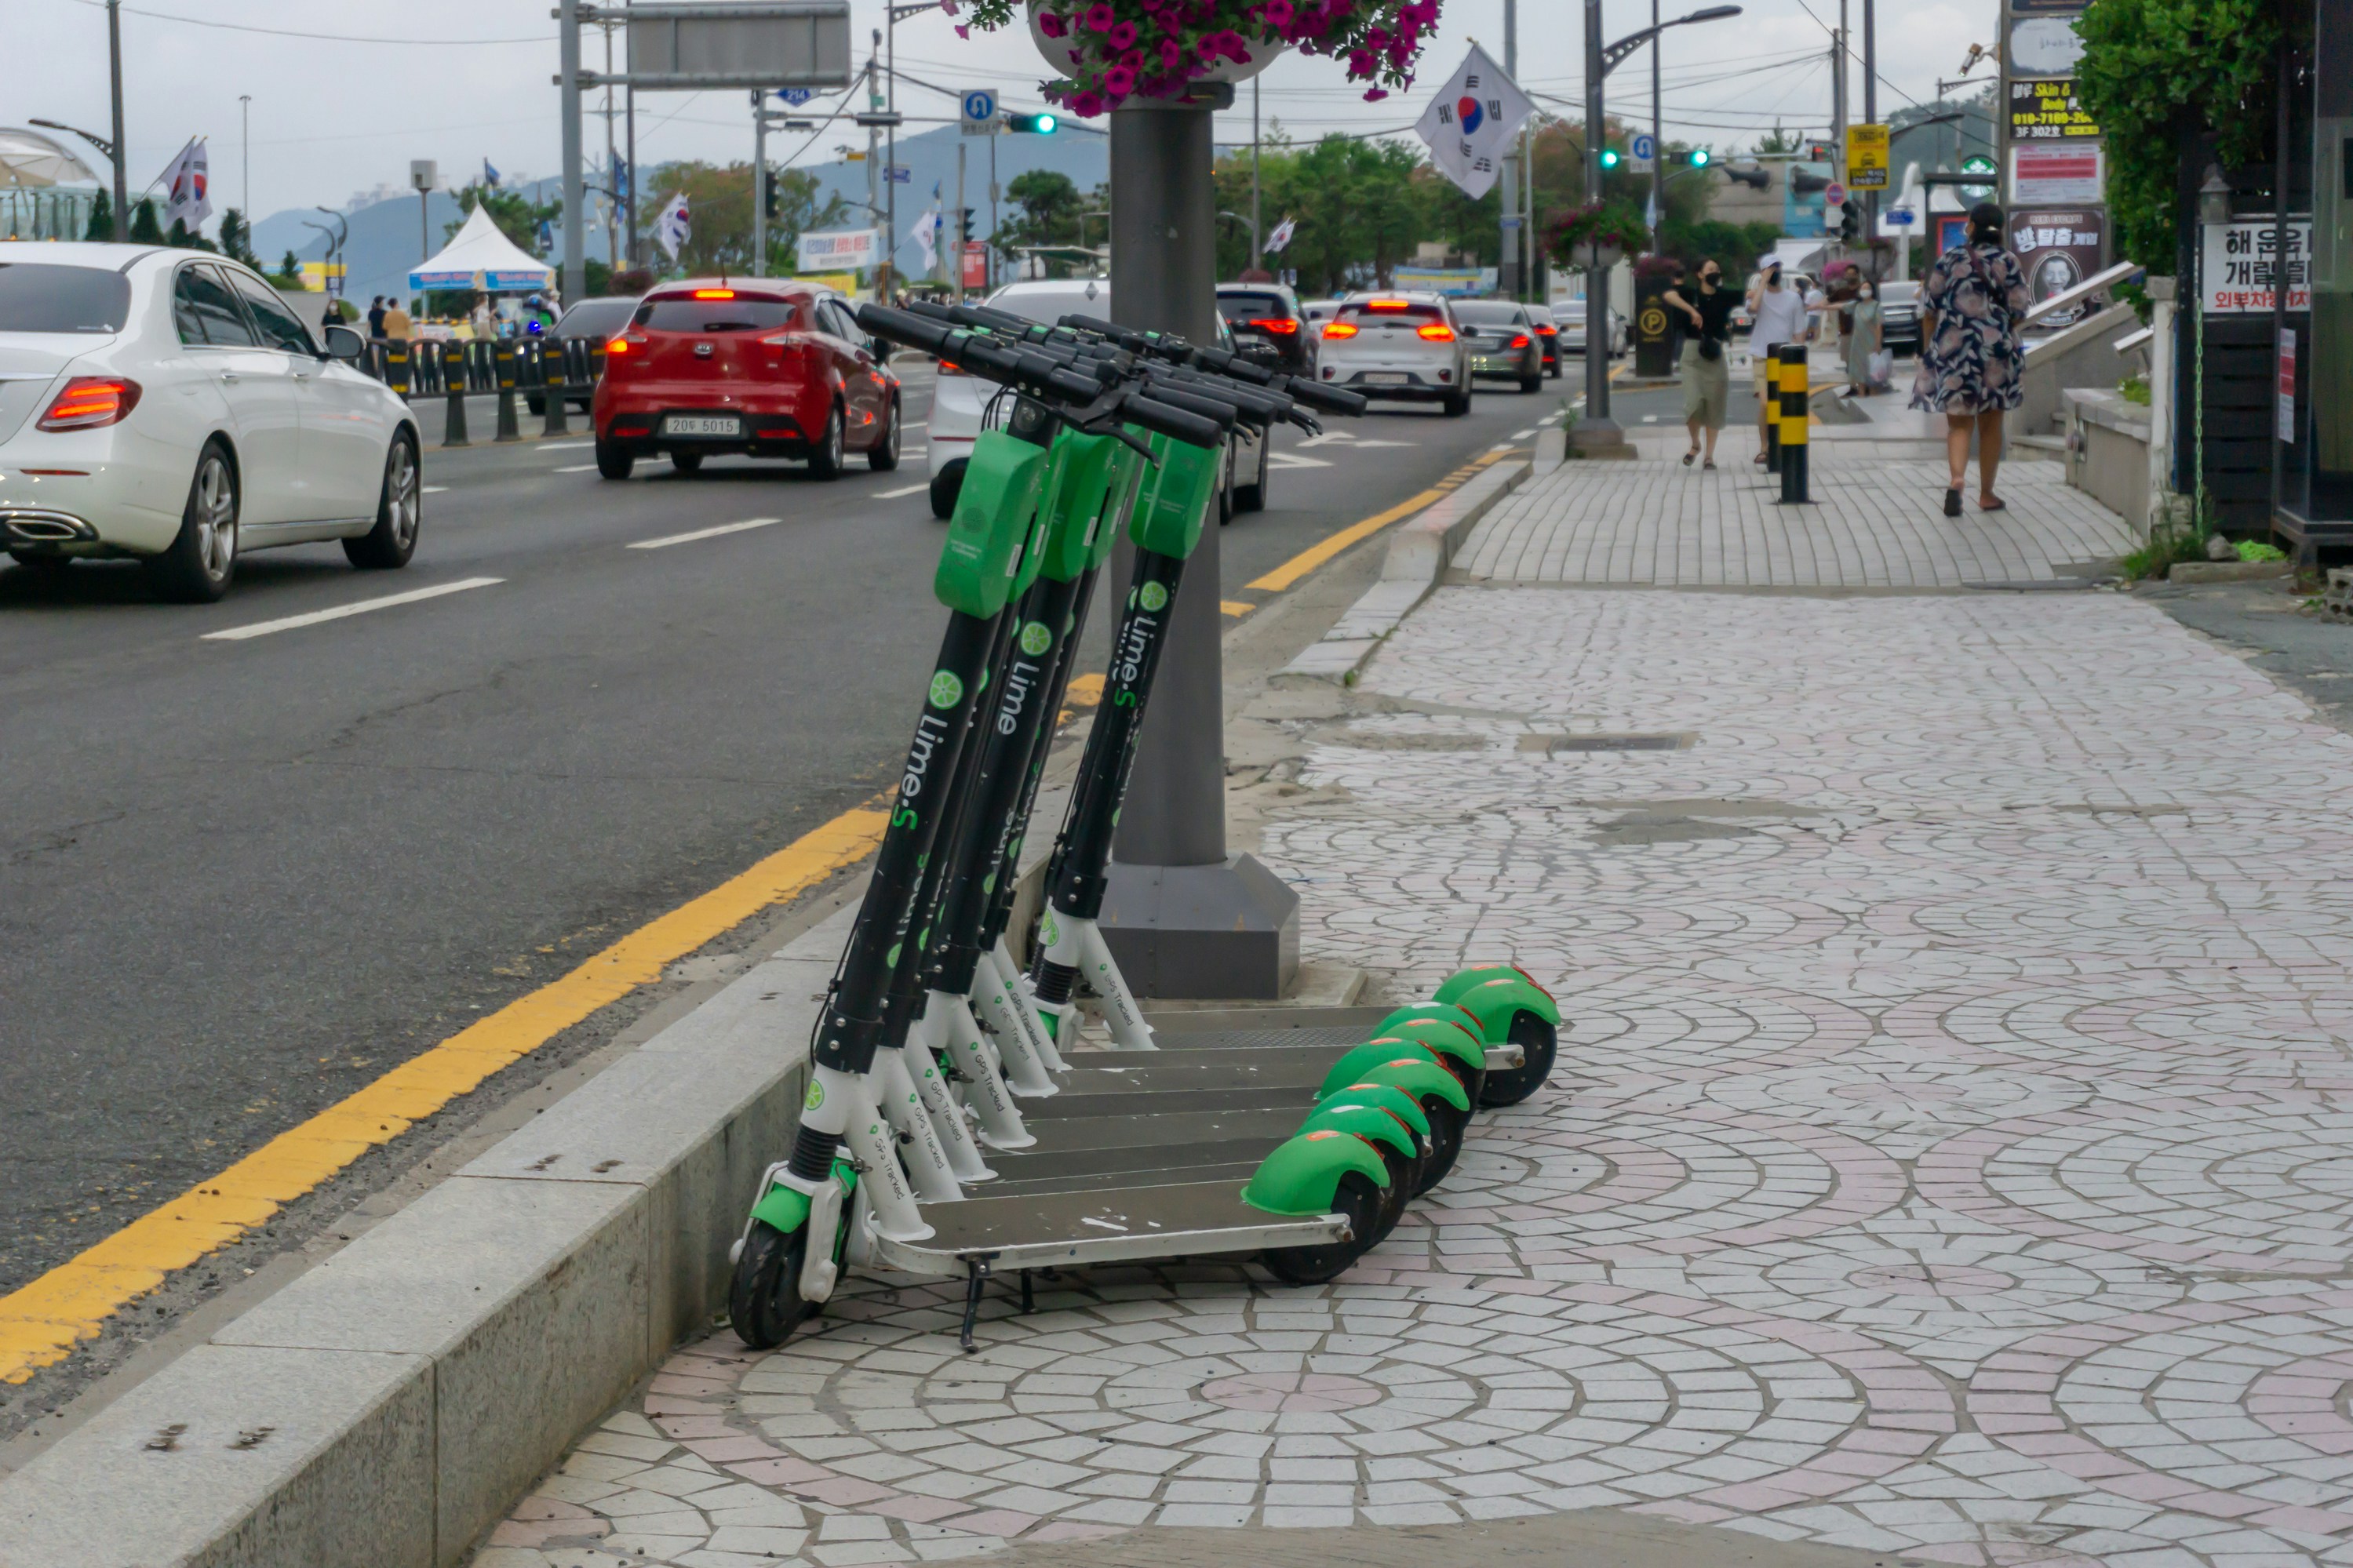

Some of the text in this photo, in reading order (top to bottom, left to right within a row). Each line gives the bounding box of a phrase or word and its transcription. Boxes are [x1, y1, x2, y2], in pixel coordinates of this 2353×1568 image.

[787, 90, 806, 100] 214
[2061, 82, 2071, 96] &
[2015, 126, 2030, 138] 3F
[702, 420, 734, 433] 5015
[997, 661, 1040, 735] Lime
[1010, 992, 1041, 1046] GPS Tracked
[1114, 991, 1135, 1027] Tracked
[974, 1054, 1006, 1113] GPS Tracked
[931, 1081, 963, 1142] GPS Tracked
[914, 1107, 945, 1170] GPS Tracked
[884, 1159, 905, 1200] Tracked
